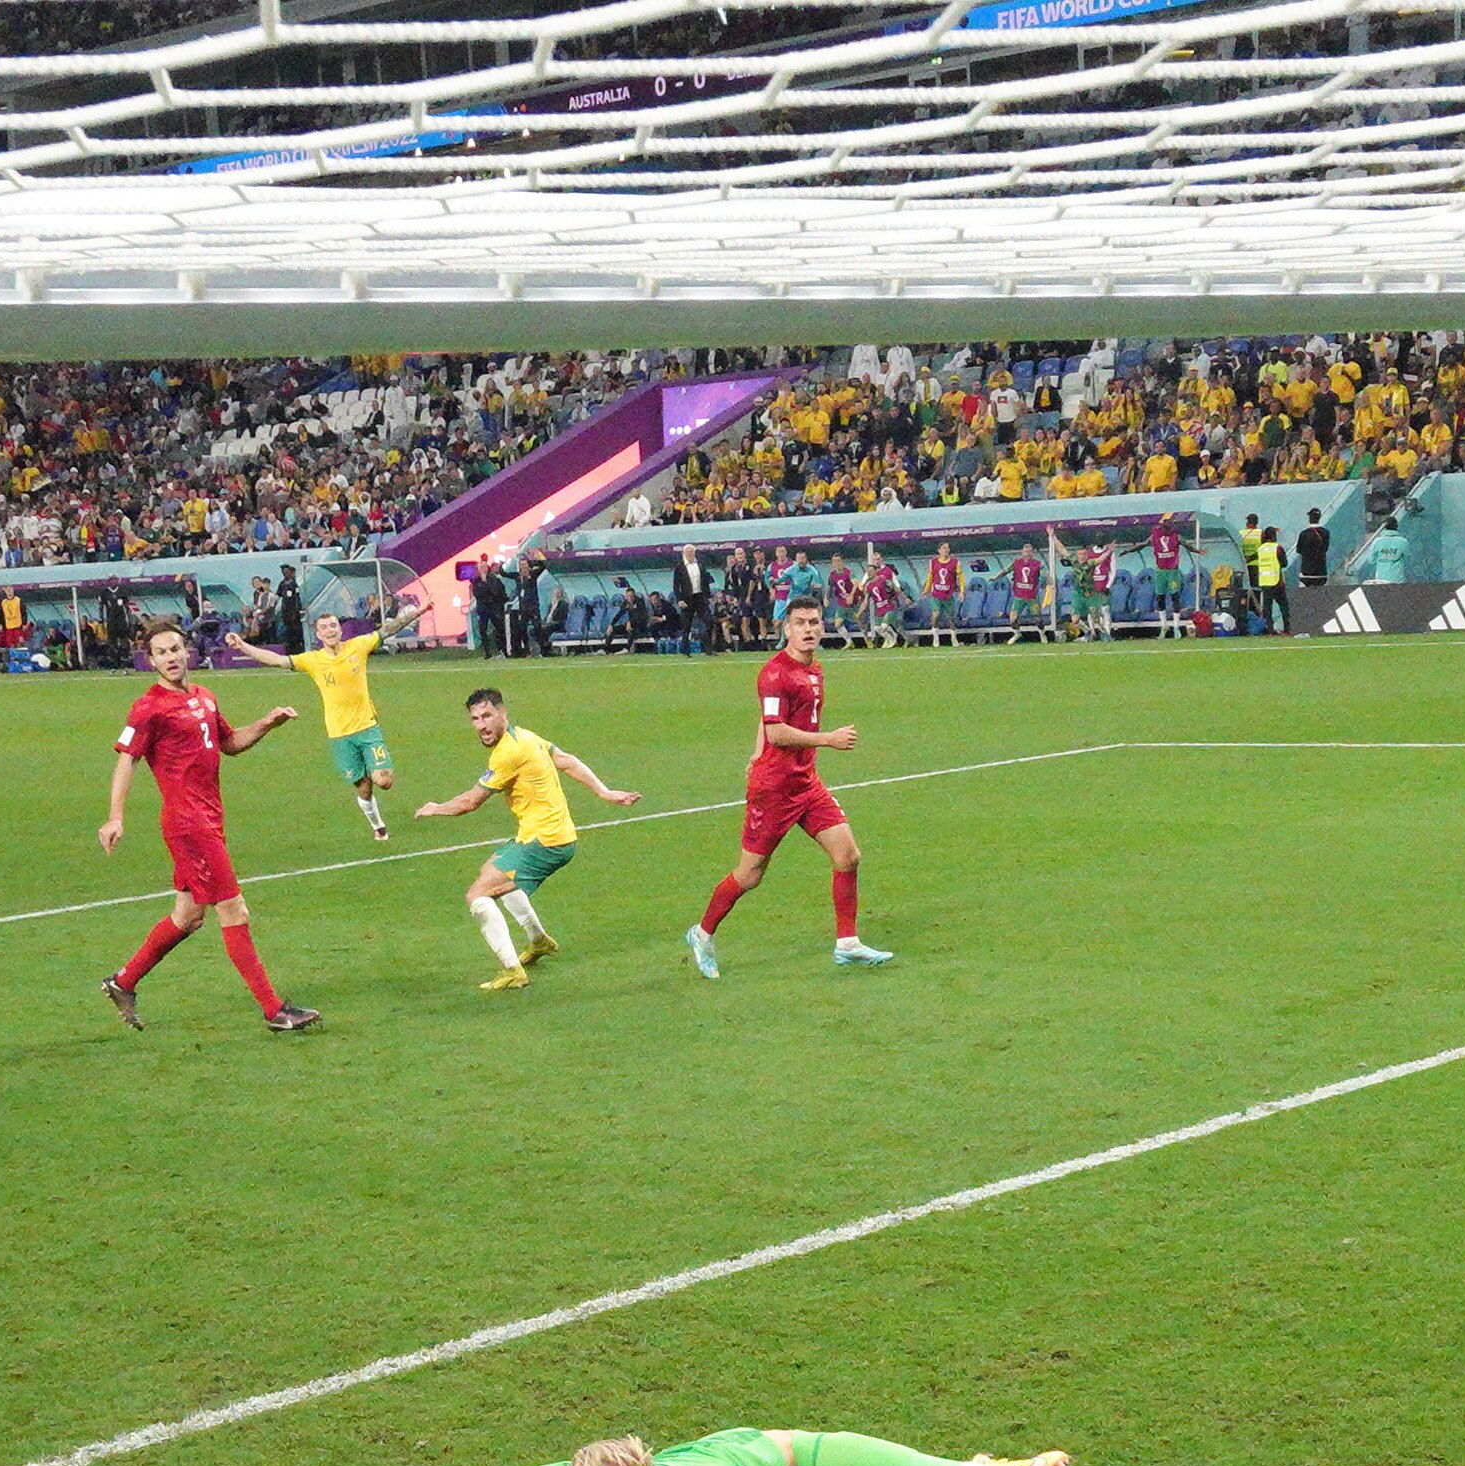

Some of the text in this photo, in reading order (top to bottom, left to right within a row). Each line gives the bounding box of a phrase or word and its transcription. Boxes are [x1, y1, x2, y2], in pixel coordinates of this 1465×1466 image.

[996, 8, 1040, 30] FIFA
[568, 86, 631, 110] AUSTRALIA
[200, 722, 214, 749] 2
[371, 744, 386, 761] 14
